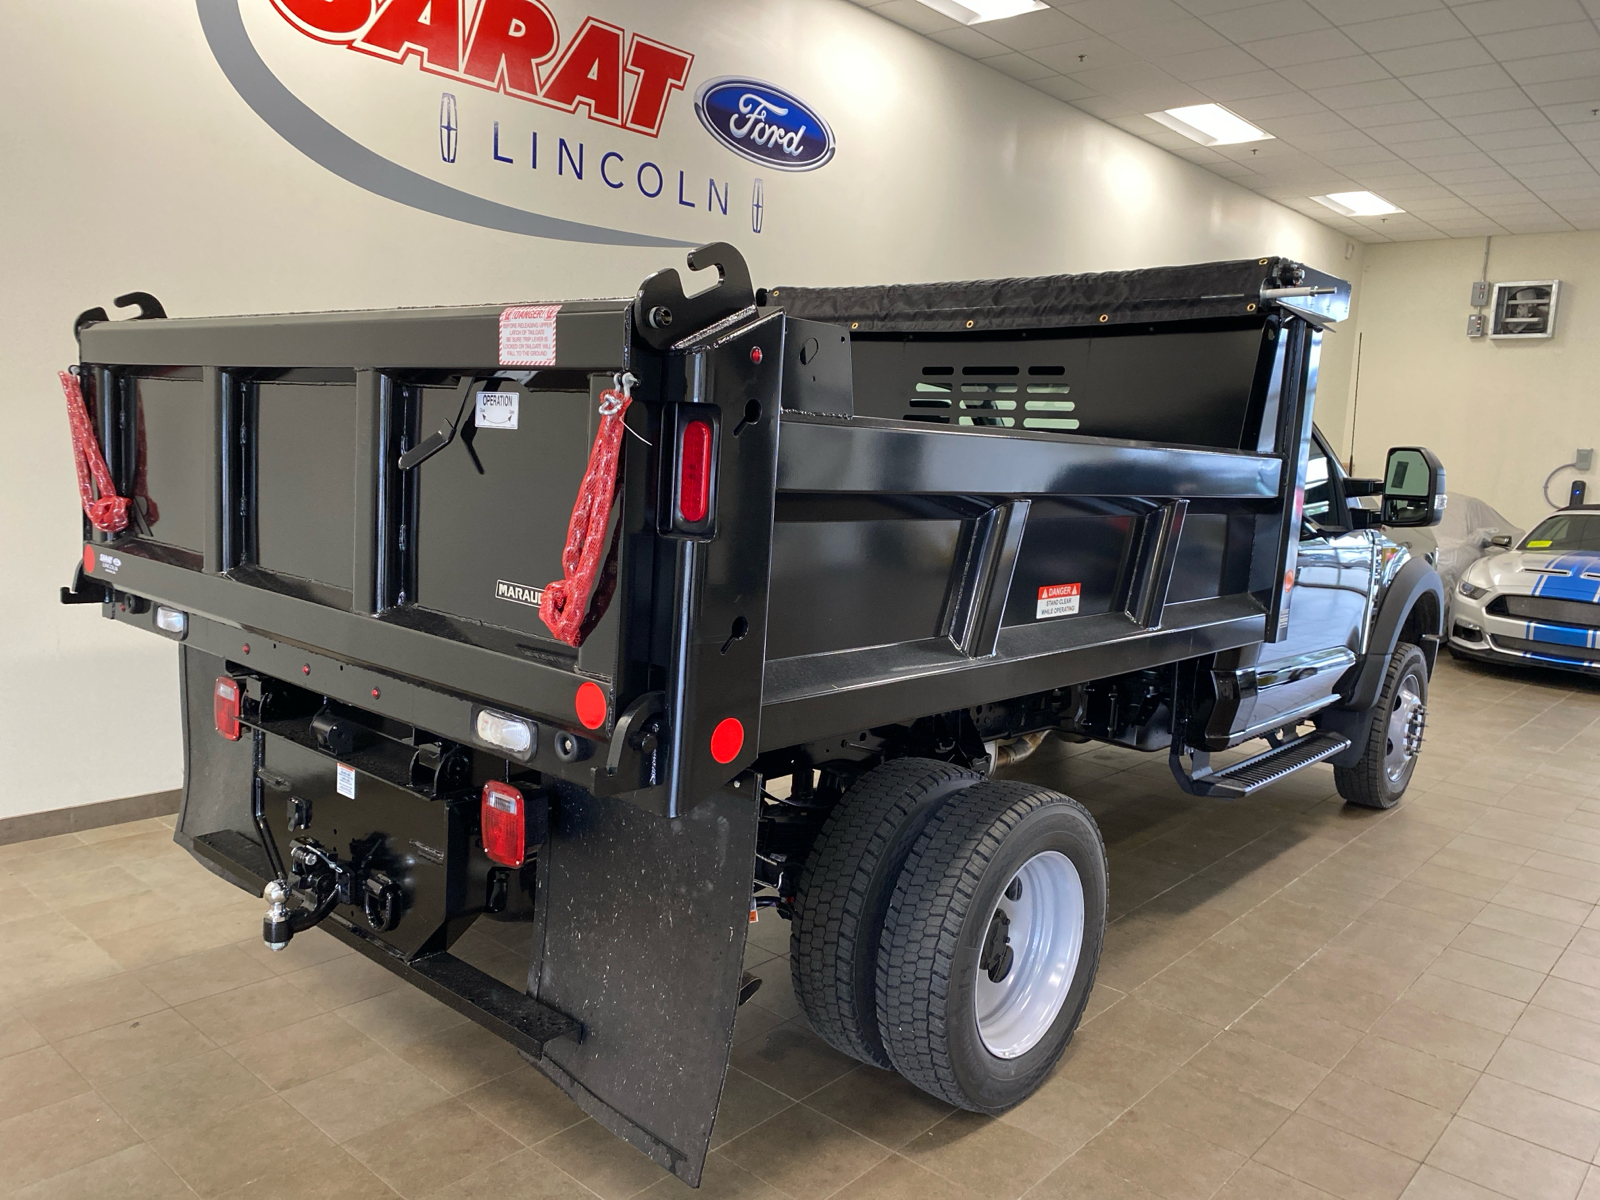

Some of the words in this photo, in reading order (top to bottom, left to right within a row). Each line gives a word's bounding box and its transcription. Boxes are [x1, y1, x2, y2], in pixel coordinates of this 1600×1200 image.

[730, 92, 805, 159] Ford
[492, 121, 730, 216] LINCOLN
[482, 394, 513, 407] OPERATION
[1048, 586, 1072, 597] DANGER
[1046, 599, 1058, 607] STAND
[1053, 605, 1075, 614] OPERATING
